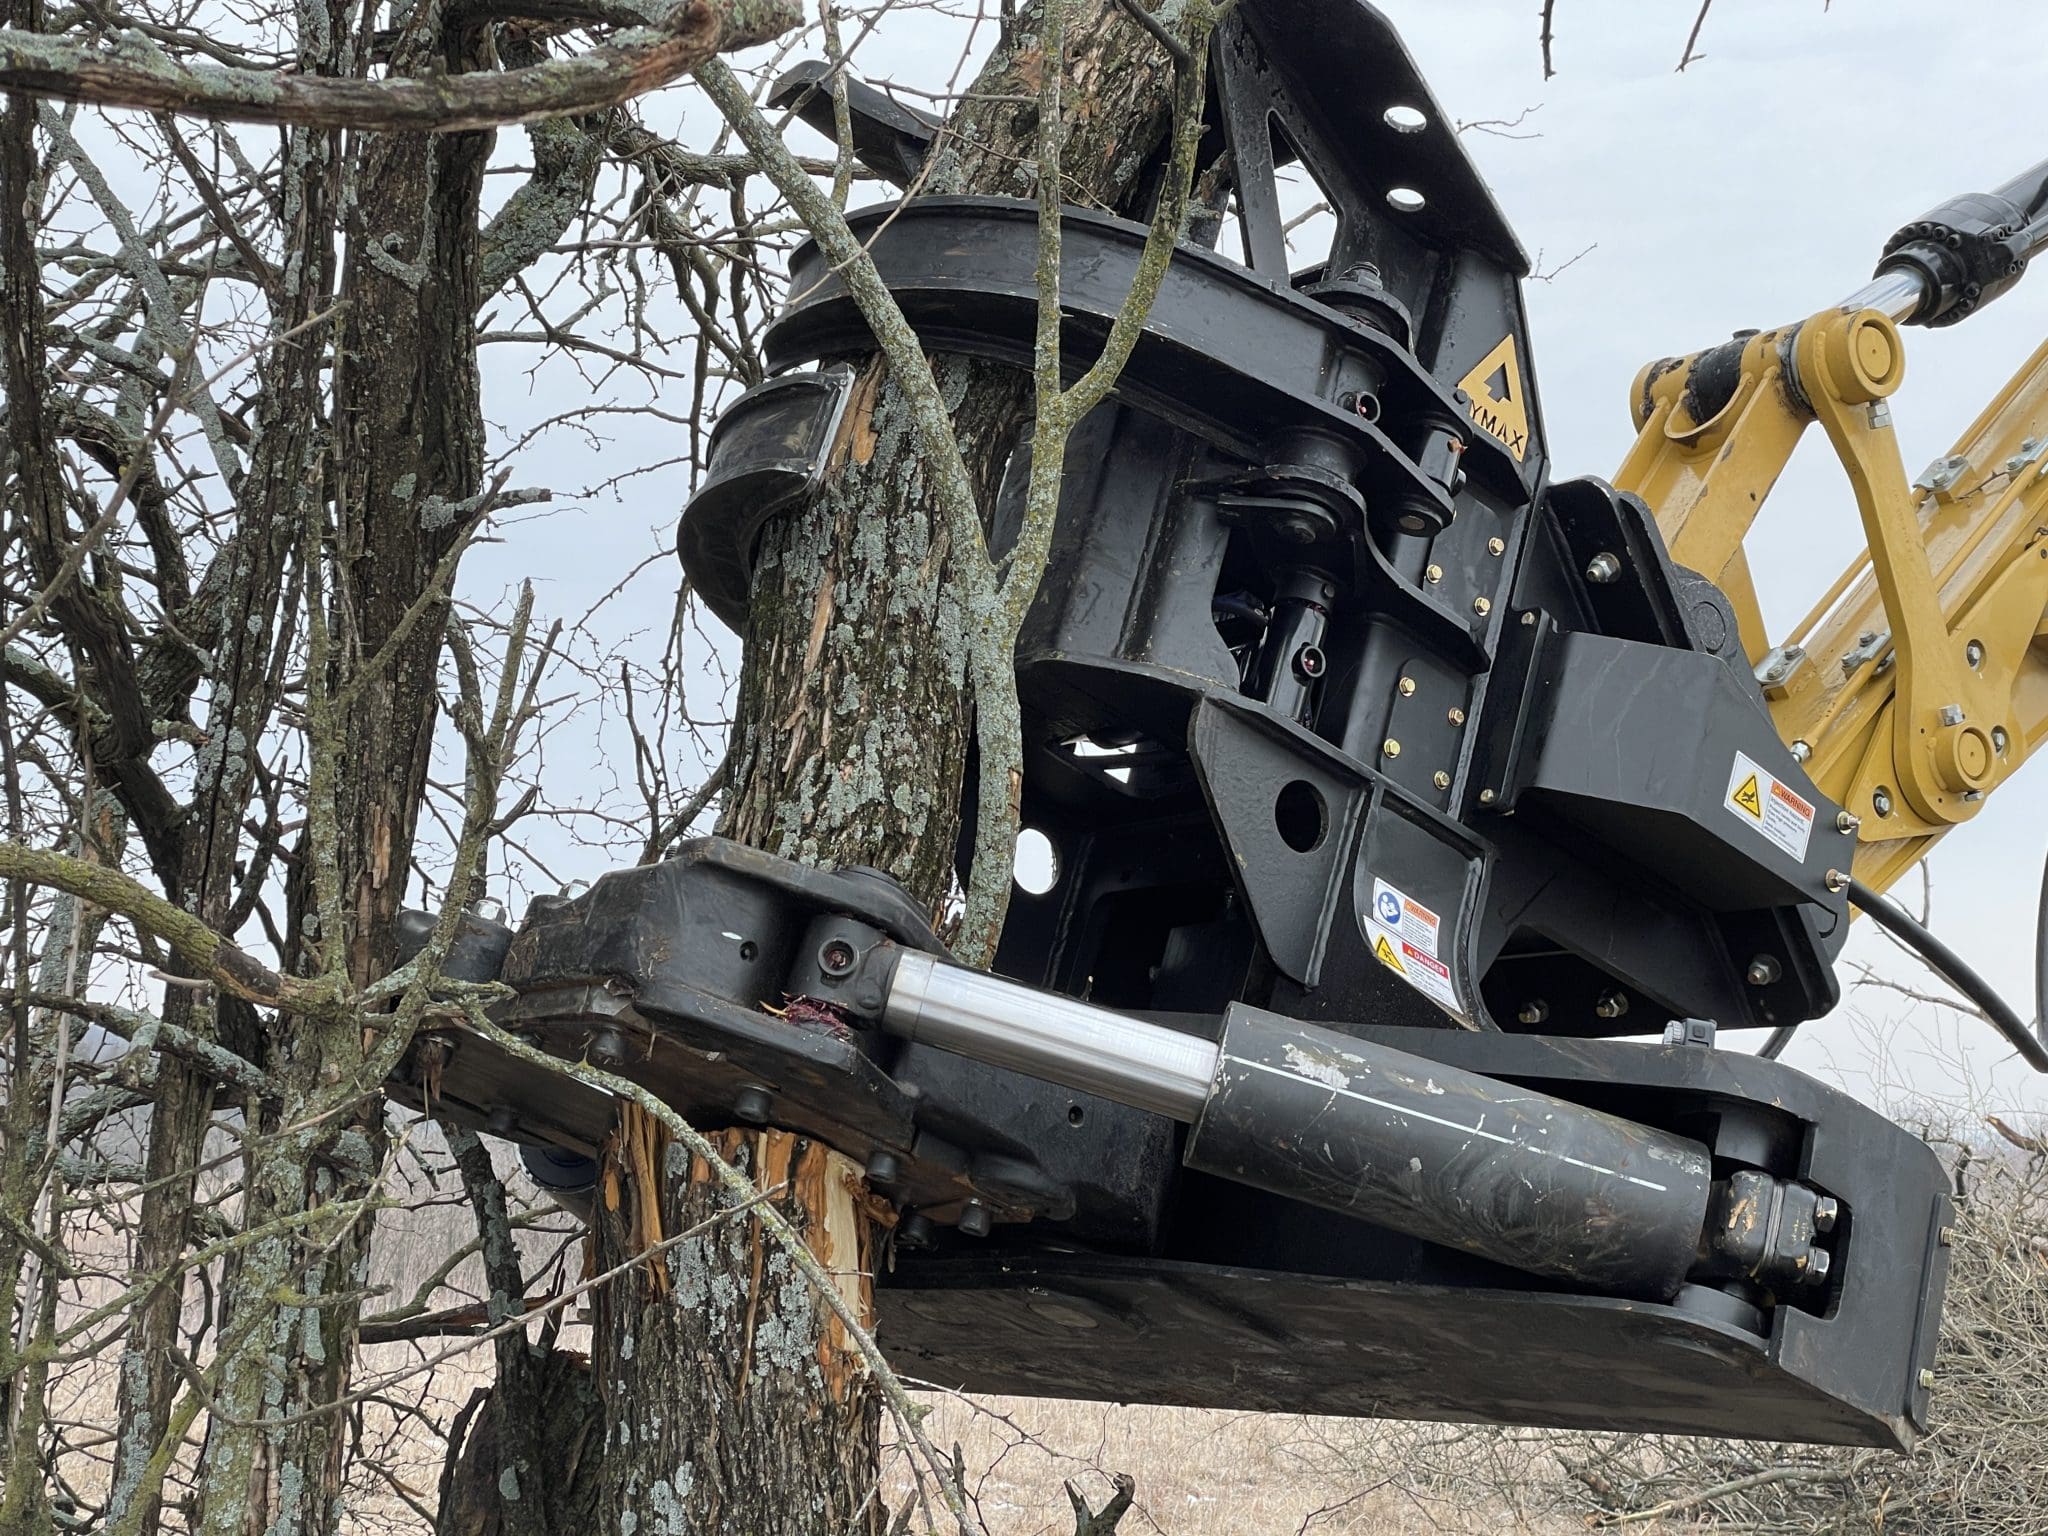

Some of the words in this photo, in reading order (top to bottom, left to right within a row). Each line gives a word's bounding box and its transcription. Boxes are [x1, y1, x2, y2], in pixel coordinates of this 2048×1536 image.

[1471, 399, 1524, 454] YMAX
[1780, 791, 1811, 818] WARNING
[1414, 952, 1444, 975] DANGER
